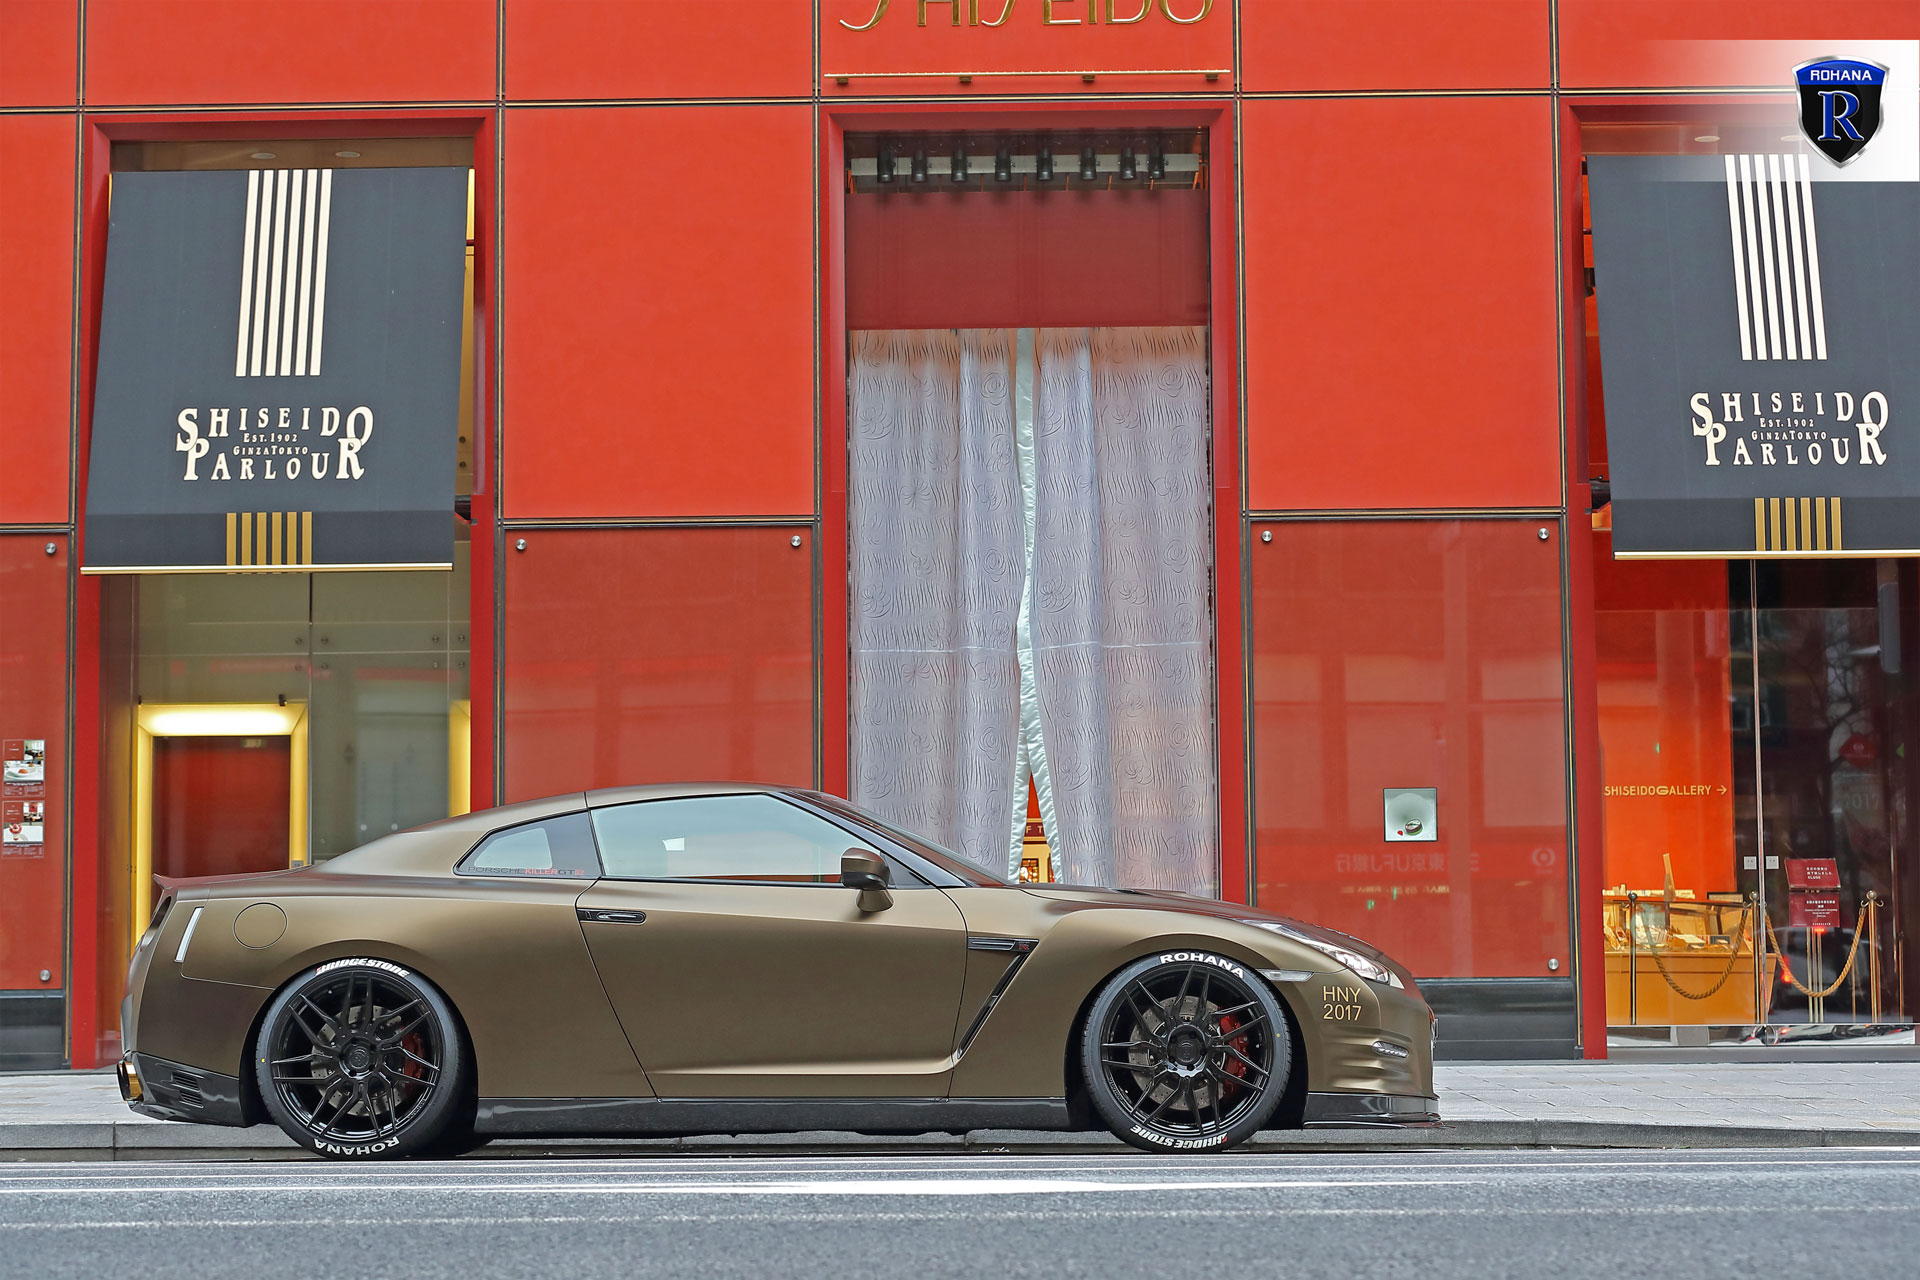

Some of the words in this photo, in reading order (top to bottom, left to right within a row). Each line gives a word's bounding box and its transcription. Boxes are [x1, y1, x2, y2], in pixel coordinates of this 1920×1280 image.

[1690, 391, 1889, 436] SHISEIDO
[176, 405, 374, 452] SHISEIDO
[1705, 422, 1887, 466] PARLOUR
[183, 437, 365, 481] PARLOUR
[314, 958, 411, 978] BRIDGESTONE
[1160, 952, 1244, 979] ROHANA
[1323, 985, 1361, 1003] HNY
[1323, 1003, 1362, 1021] 2017
[313, 1136, 400, 1156] ROHANA
